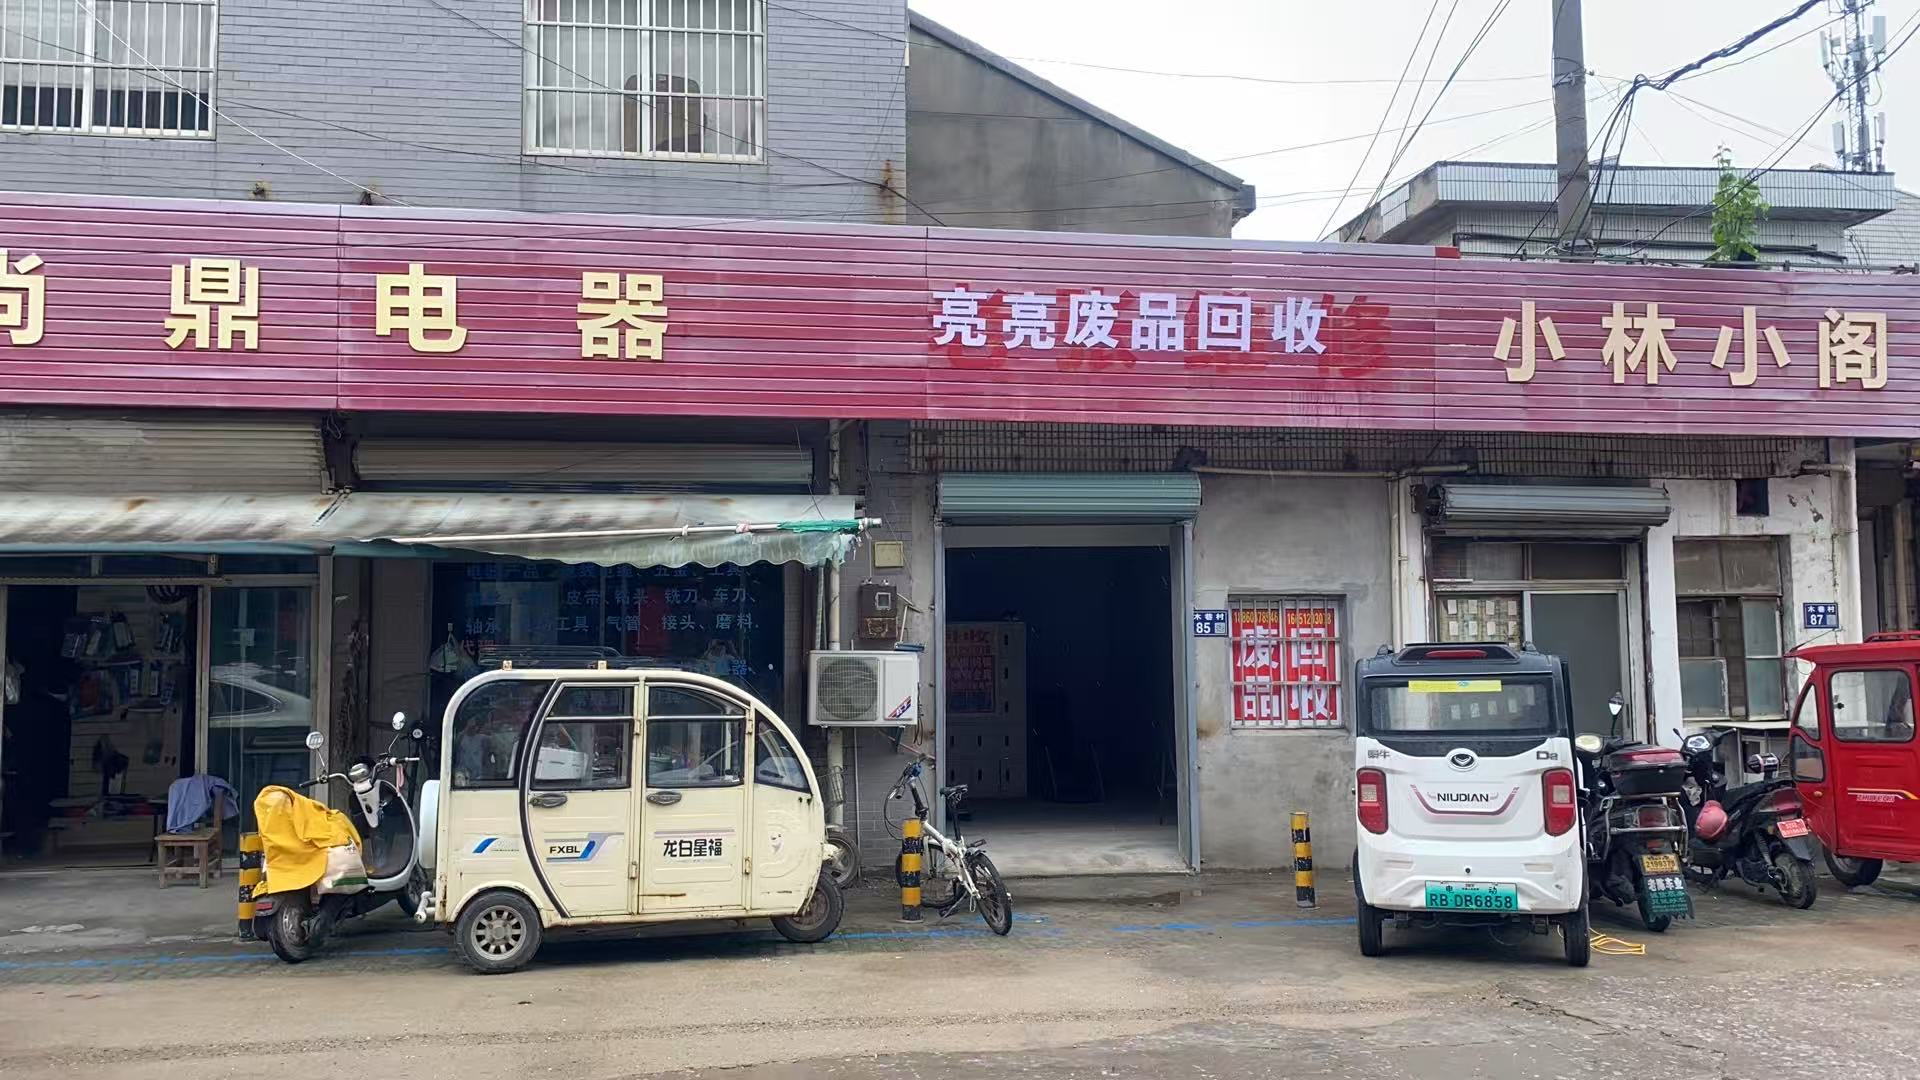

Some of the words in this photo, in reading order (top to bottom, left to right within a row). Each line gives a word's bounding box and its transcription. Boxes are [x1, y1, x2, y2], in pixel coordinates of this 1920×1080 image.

[933, 287, 1328, 355] 亮亮废品回收
[1493, 301, 1888, 390] 小林小阁
[1811, 614, 1823, 625] 87
[1196, 622, 1211, 633] 85
[1437, 793, 1489, 802] NIUDIAN
[549, 845, 581, 854] FXBL
